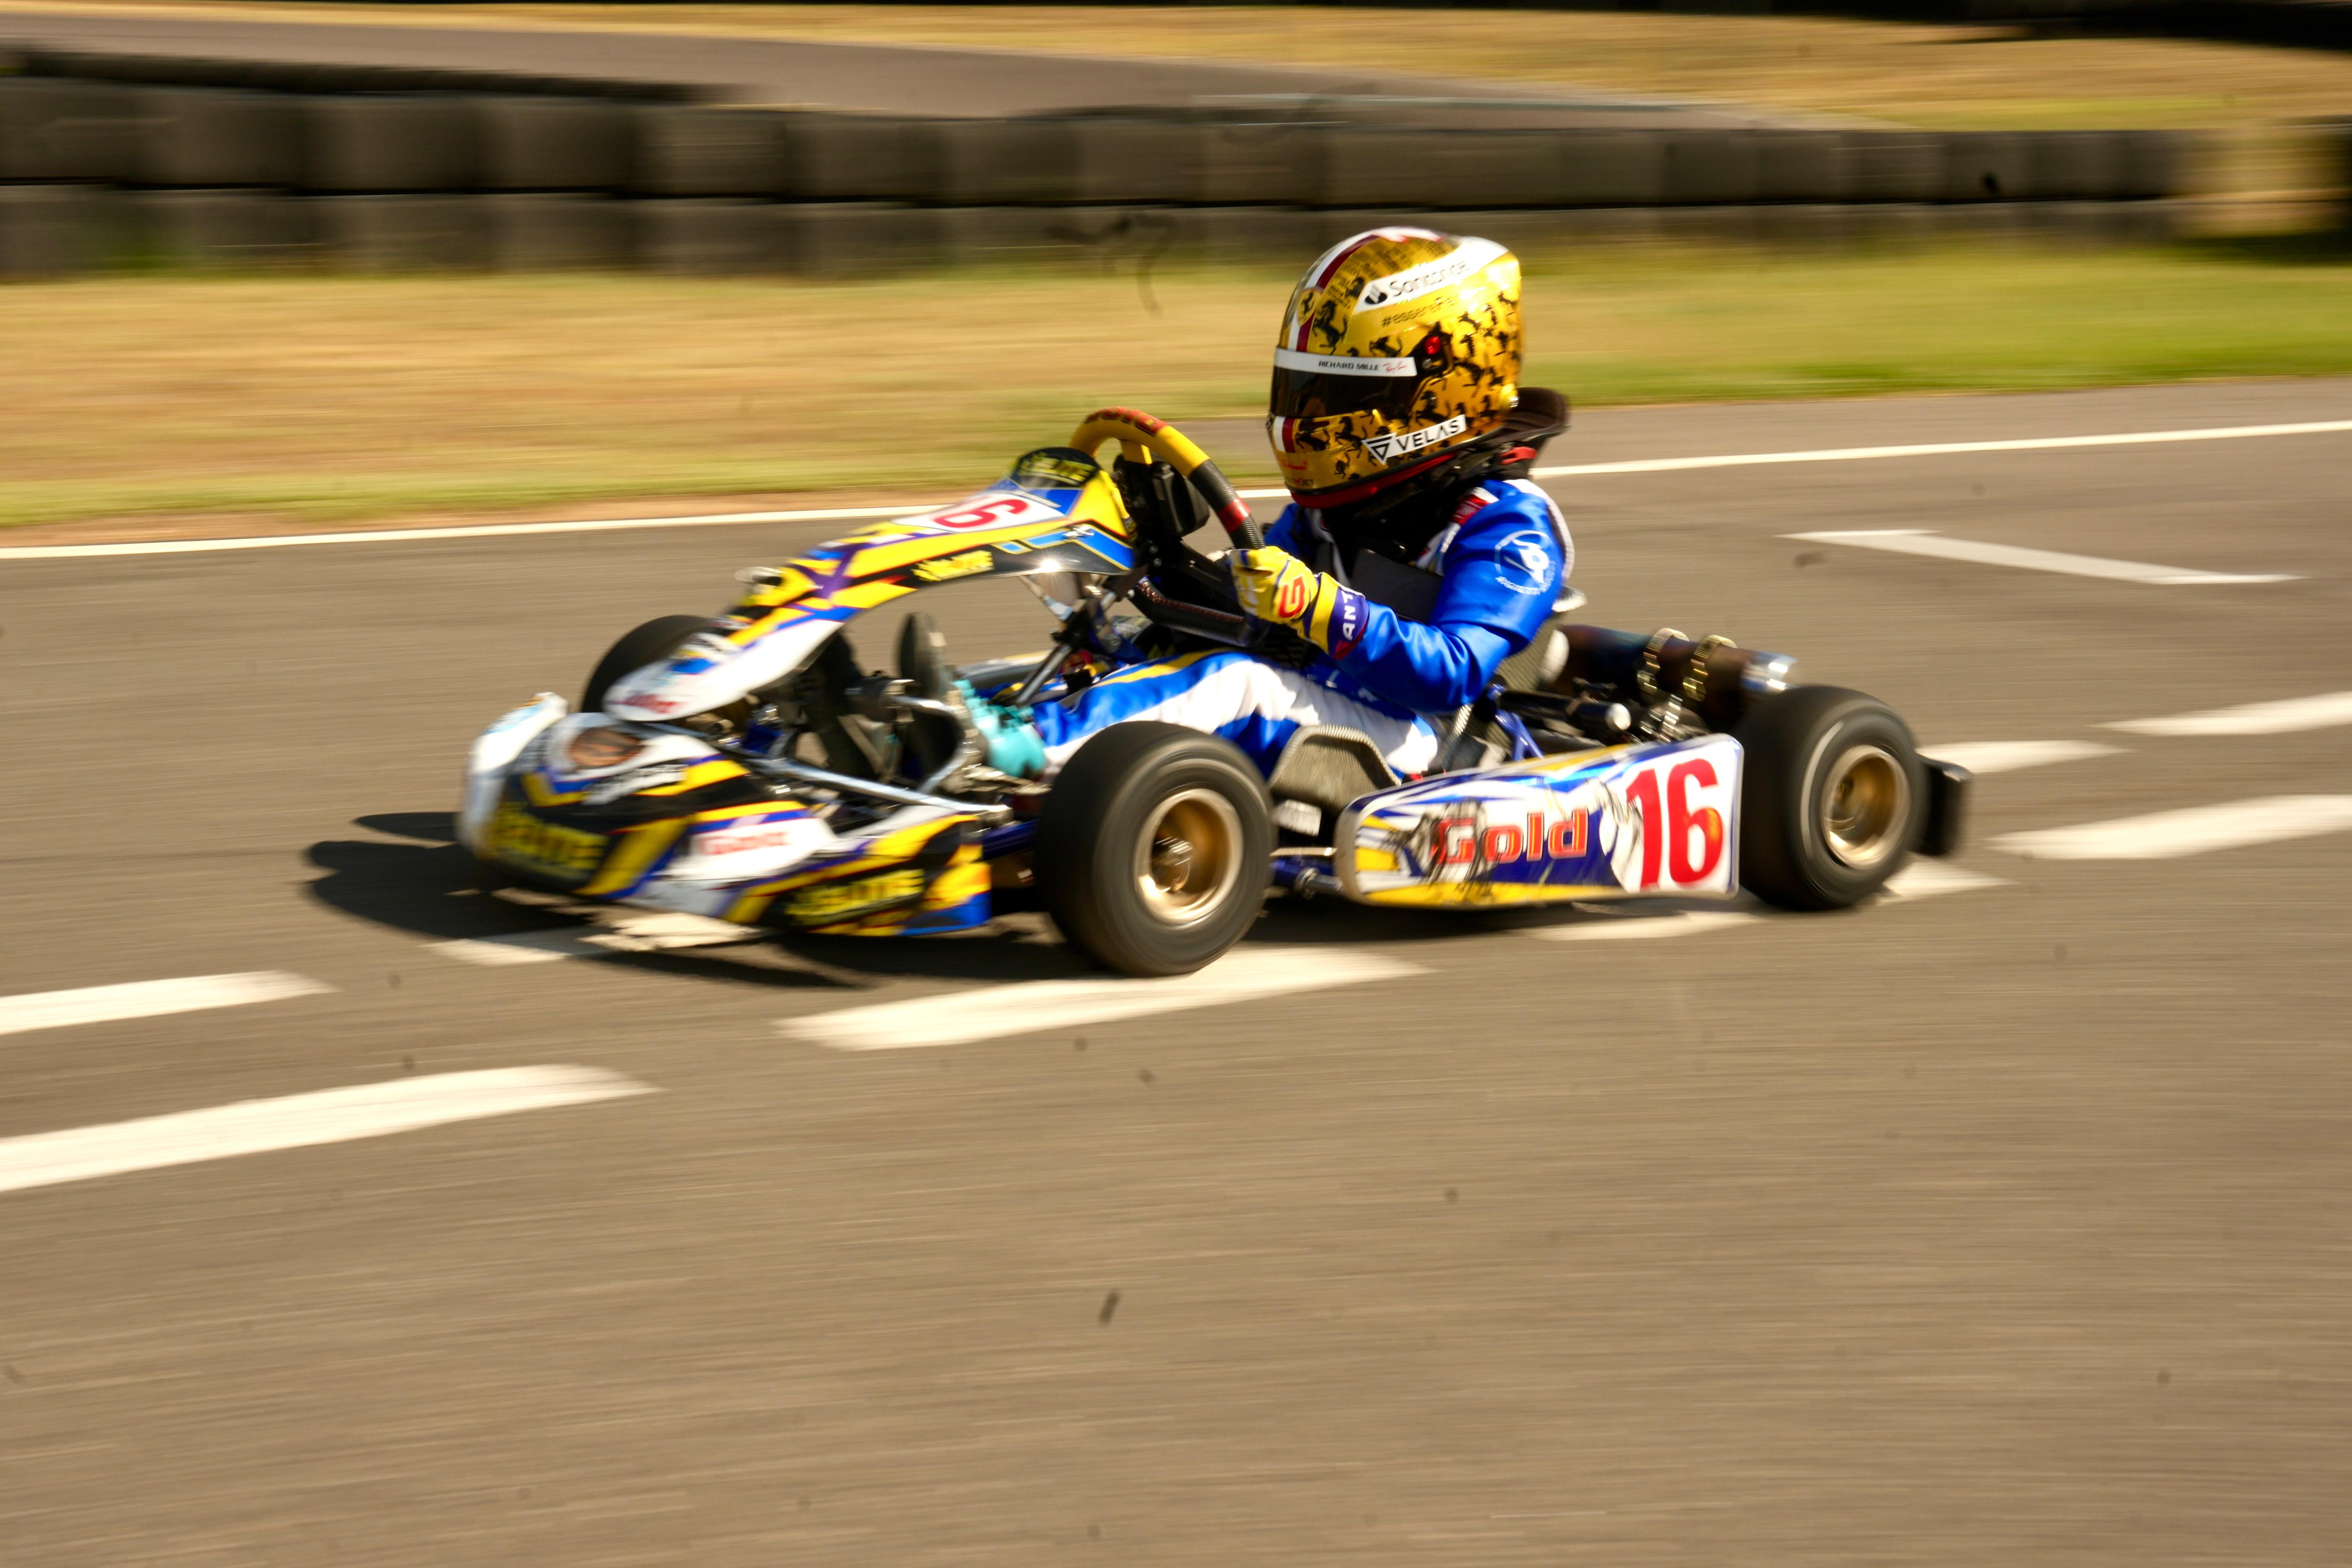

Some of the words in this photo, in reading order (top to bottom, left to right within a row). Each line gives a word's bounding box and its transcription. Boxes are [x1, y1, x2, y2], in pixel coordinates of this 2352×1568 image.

[1319, 360, 1354, 370] RICHARD
[1356, 362, 1380, 371] MILLE
[1396, 419, 1460, 452] VELAS
[1435, 808, 1589, 864] Gold
[1626, 758, 1724, 892] 16
